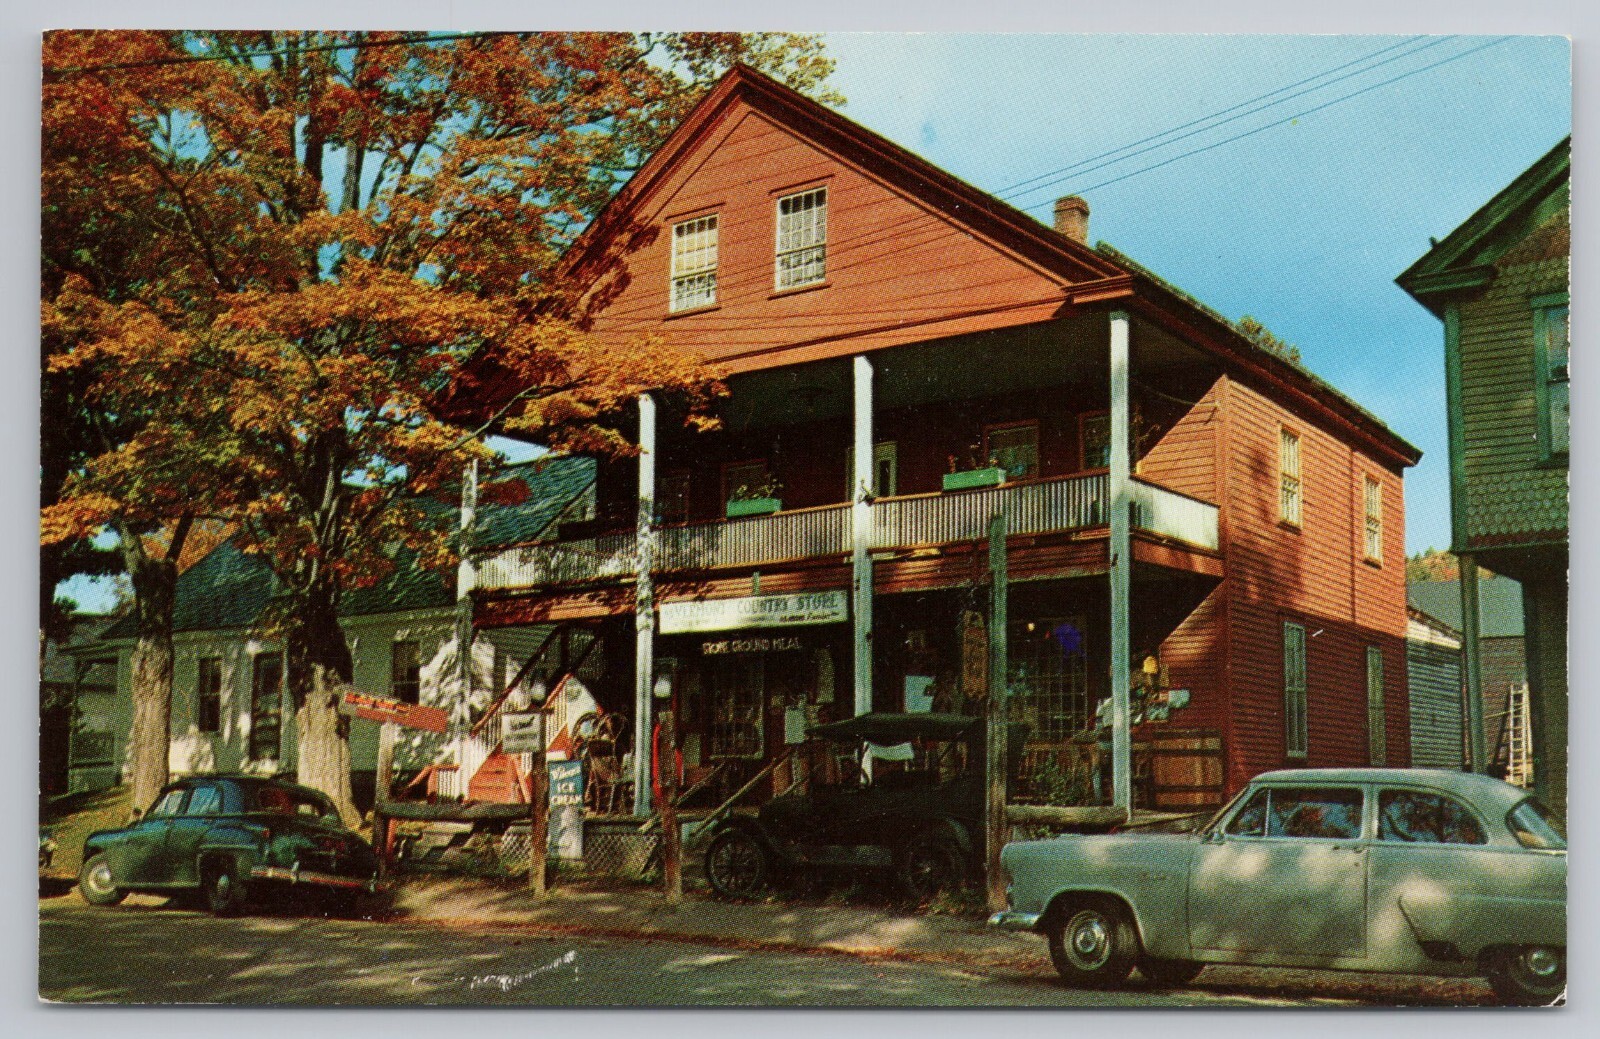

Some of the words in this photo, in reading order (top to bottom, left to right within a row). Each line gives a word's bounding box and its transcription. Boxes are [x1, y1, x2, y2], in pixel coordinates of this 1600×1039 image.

[737, 597, 788, 614] COUNTRY
[797, 593, 838, 611] STORE
[731, 639, 769, 652] GROUND
[773, 637, 803, 651] MEAL
[556, 781, 576, 792] ICE
[550, 794, 582, 805] CREAM
